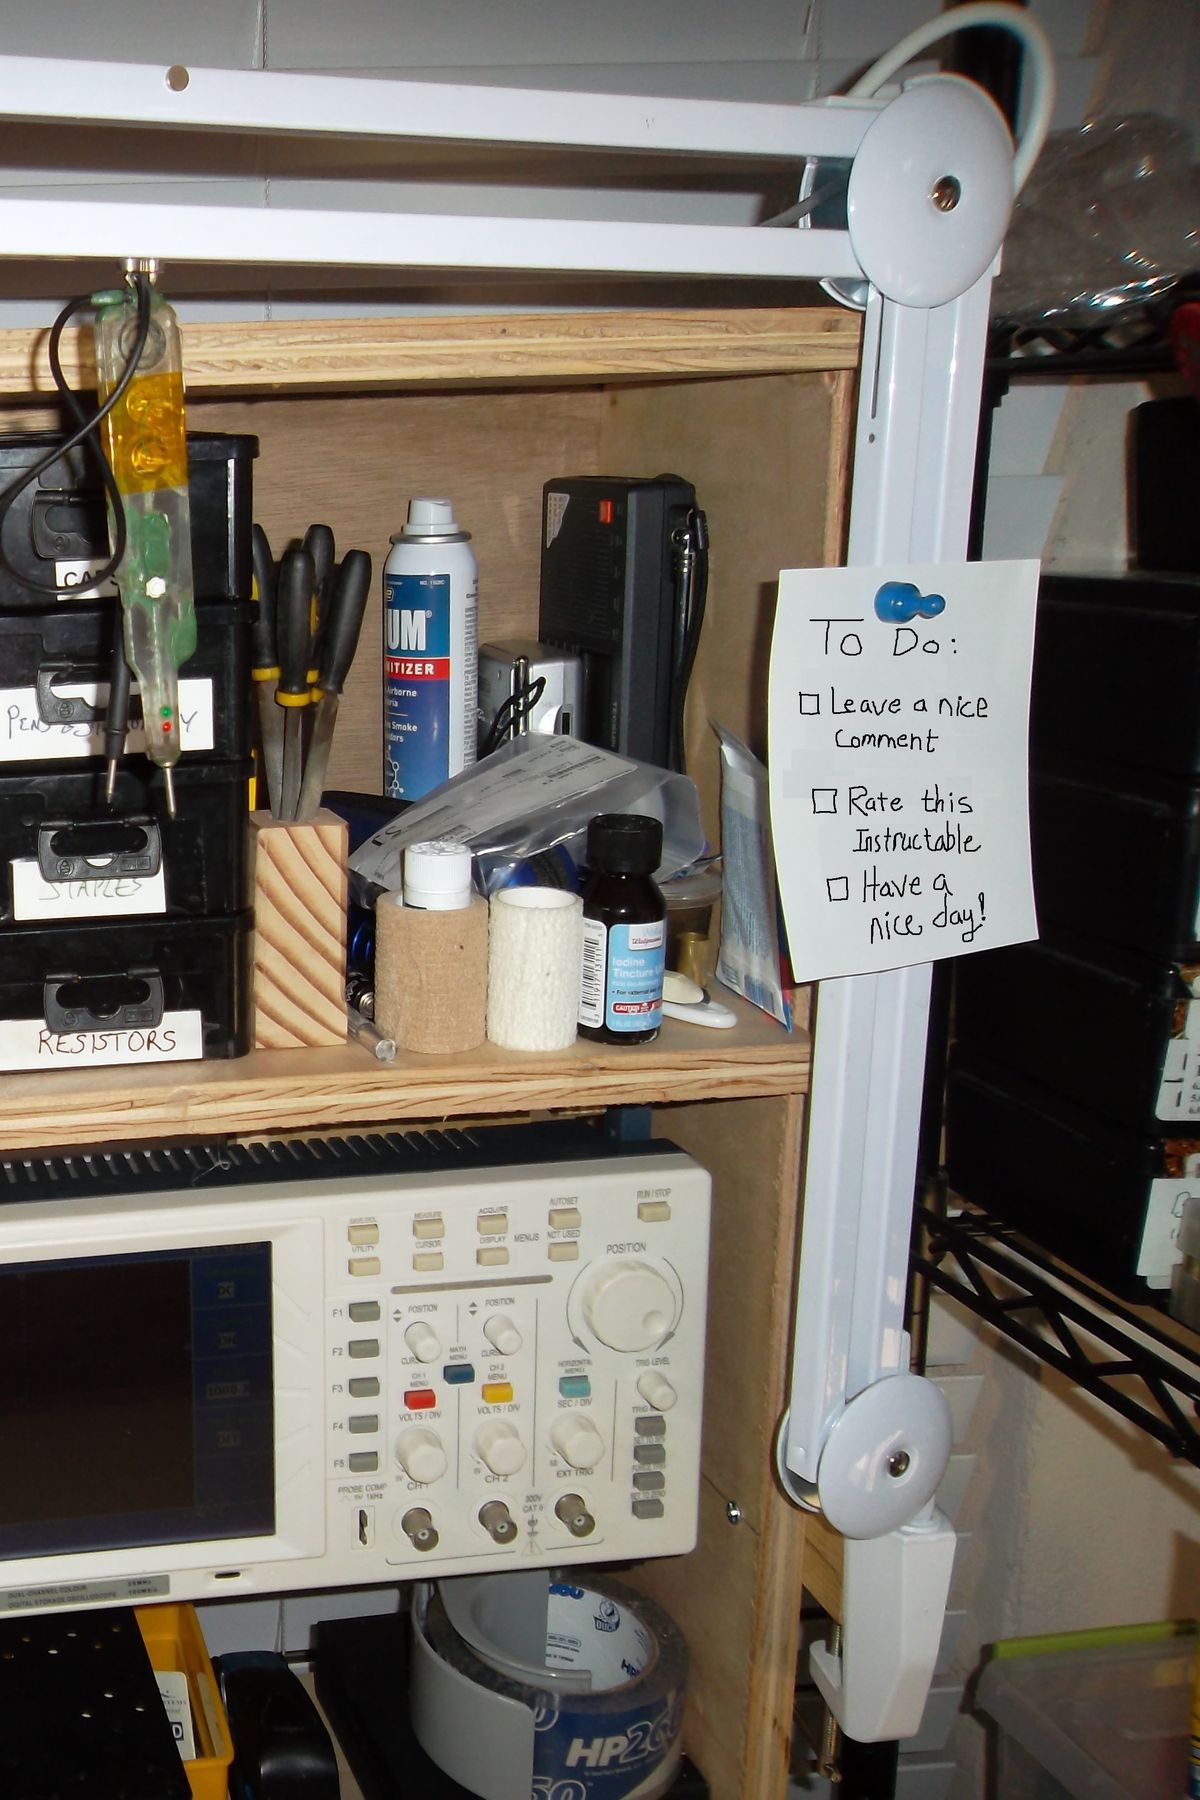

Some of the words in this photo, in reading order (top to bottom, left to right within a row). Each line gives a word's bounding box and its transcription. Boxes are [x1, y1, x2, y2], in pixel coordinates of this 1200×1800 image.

[809, 618, 864, 656] To
[831, 686, 902, 715] Leave
[913, 697, 928, 713] a
[938, 695, 989, 718] nice
[392, 722, 418, 732] Smoke
[835, 728, 939, 753] Comment
[848, 785, 904, 816] Rate
[921, 784, 974, 814] this
[852, 821, 982, 854] Instructable
[862, 865, 922, 903] Have
[933, 873, 953, 896] a
[870, 911, 924, 944] nice
[933, 892, 986, 943] day!
[613, 958, 645, 967] Iodine
[38, 1030, 176, 1055] RESISTORS
[514, 1233, 539, 1242] MENUS
[562, 1230, 580, 1238] USED
[415, 1240, 441, 1249] CURSOR
[606, 1242, 646, 1254] POSITION
[485, 1298, 515, 1306] POSITION
[408, 1304, 438, 1313] POSITION
[332, 1347, 343, 1356] F2
[652, 1357, 670, 1365] LEVEL
[332, 1385, 343, 1393] F3
[557, 1400, 572, 1408] SEC
[580, 1399, 592, 1407] DIV
[477, 1406, 501, 1415] VOLTS
[507, 1404, 520, 1412] DIV
[399, 1412, 423, 1422] VOLTS
[429, 1411, 442, 1419] DIV
[334, 1459, 344, 1467] F5
[557, 1470, 571, 1478] EXT
[574, 1469, 594, 1477] TRIG
[485, 1475, 500, 1483] CH
[338, 1486, 364, 1494] PROBE
[365, 1484, 387, 1492] COMP
[407, 1482, 422, 1490] CH
